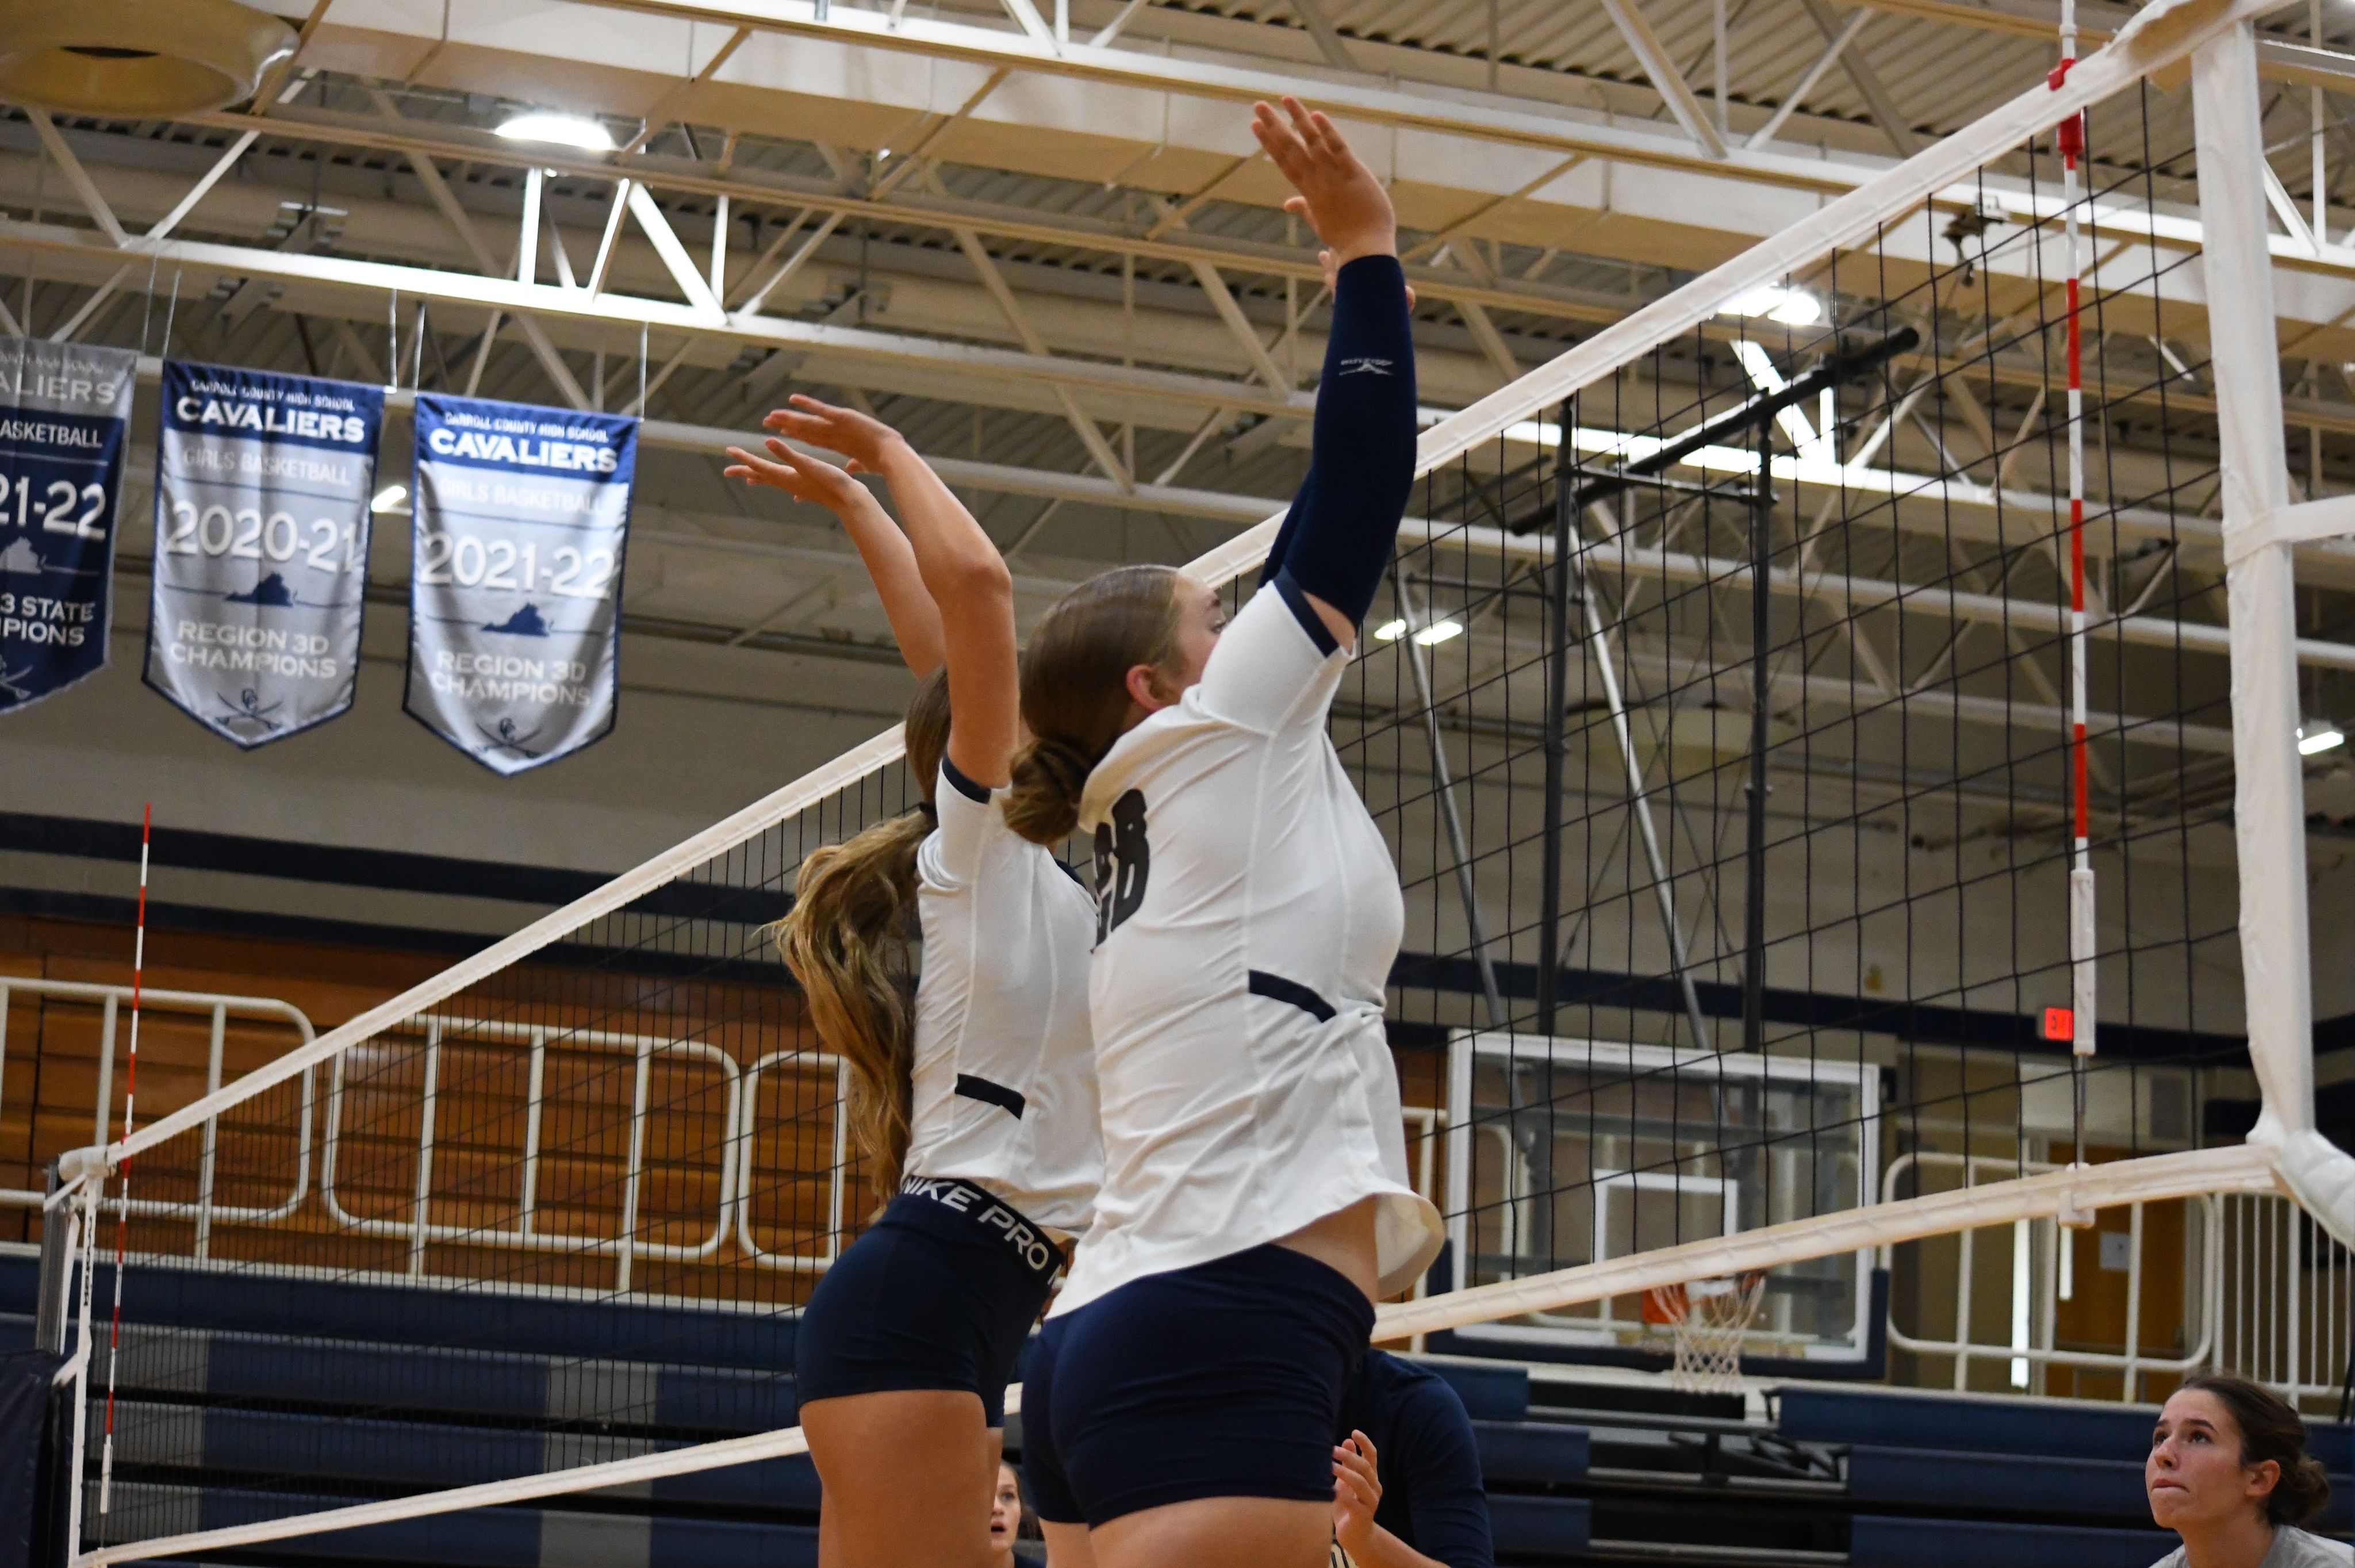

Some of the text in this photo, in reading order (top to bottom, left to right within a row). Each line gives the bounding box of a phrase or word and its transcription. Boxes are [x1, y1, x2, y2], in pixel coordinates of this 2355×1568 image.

[177, 396, 365, 443] CAVALIERS
[493, 417, 537, 435] COUNTY
[538, 423, 565, 438] HIGH
[566, 425, 609, 443] SCHOOL
[183, 447, 351, 486] GIRLS BASKETBALL
[429, 428, 617, 471] CAVALIERS
[0, 473, 106, 539] 1-22
[440, 478, 601, 513] GIRLS BASKETBALL
[166, 500, 356, 573] 2020-21
[420, 532, 615, 599] 2021-22
[21, 596, 95, 622] STATE
[0, 617, 85, 646] PIONS
[178, 620, 330, 656] REGION 3D
[170, 642, 337, 678] CHAMPIONS
[438, 650, 586, 683] REGION 3D
[432, 670, 591, 707] CHAMPIONS
[903, 1176, 1049, 1270] NIKE PRO
